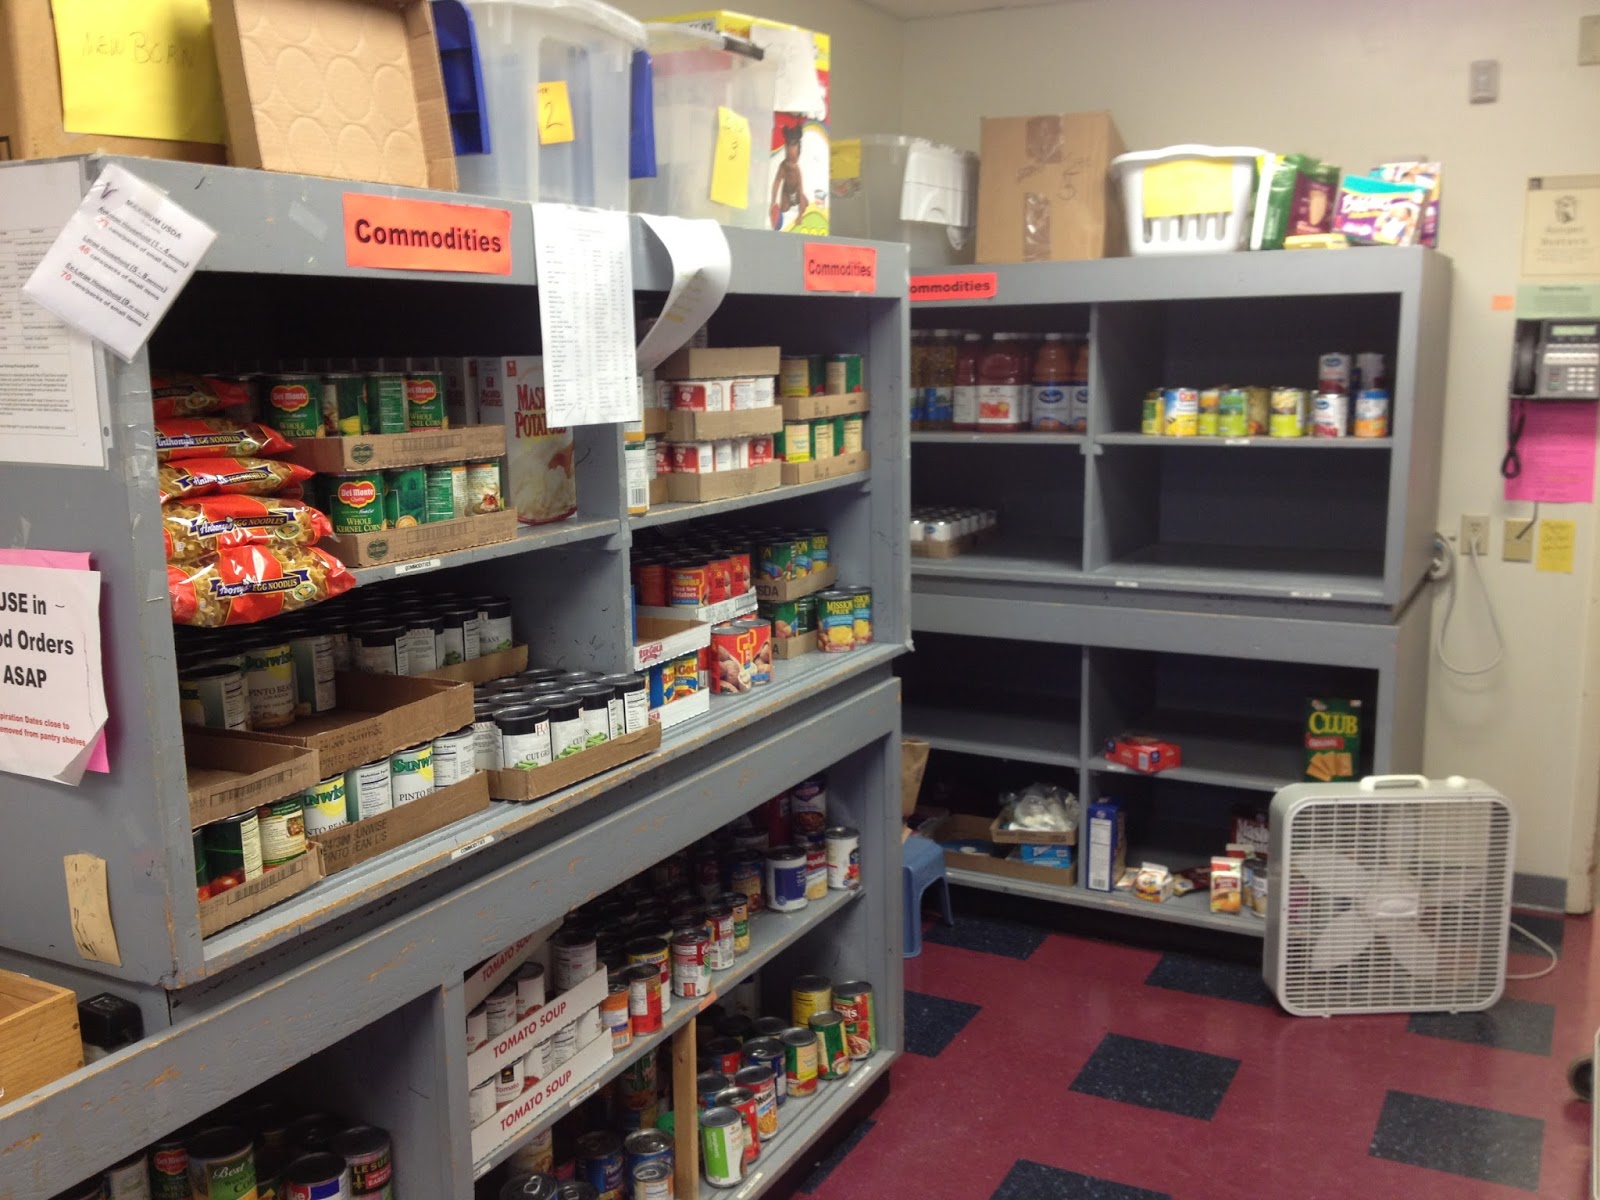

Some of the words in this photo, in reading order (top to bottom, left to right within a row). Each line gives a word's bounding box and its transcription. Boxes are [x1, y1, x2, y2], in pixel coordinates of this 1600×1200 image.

[544, 102, 564, 130] 2
[160, 222, 182, 240] USDA
[355, 218, 502, 253] Commodities
[61, 271, 72, 282] 70
[808, 259, 872, 277] Commodities
[910, 281, 991, 294] ommodities
[341, 489, 352, 497] Del
[353, 488, 374, 497] Monte
[248, 517, 284, 526] NOODLES
[336, 525, 362, 533] KERNEL
[363, 523, 381, 532] CORN
[346, 517, 372, 525] WHOLE
[252, 582, 268, 591] EGG
[268, 578, 297, 590] NOODLES
[32, 594, 47, 615] in
[826, 600, 853, 610] MISSION
[17, 630, 74, 655] Orders
[3, 664, 47, 688] ASAP
[25, 715, 43, 726] Dates
[44, 719, 62, 729] close
[62, 721, 70, 730] to
[1308, 711, 1358, 735] CLUB
[0, 726, 23, 737] emoved
[24, 728, 38, 739] from
[40, 732, 60, 744] pantry
[62, 734, 86, 747] shelves
[399, 791, 422, 802] PINTO
[482, 948, 514, 981] TOMATO
[492, 1021, 537, 1059] TOMATO
[540, 1001, 567, 1028] SOUP
[500, 1092, 543, 1131] TOMATO
[546, 1069, 572, 1098] SOUP
[212, 1163, 245, 1180] Best
[354, 1165, 368, 1174] LE
